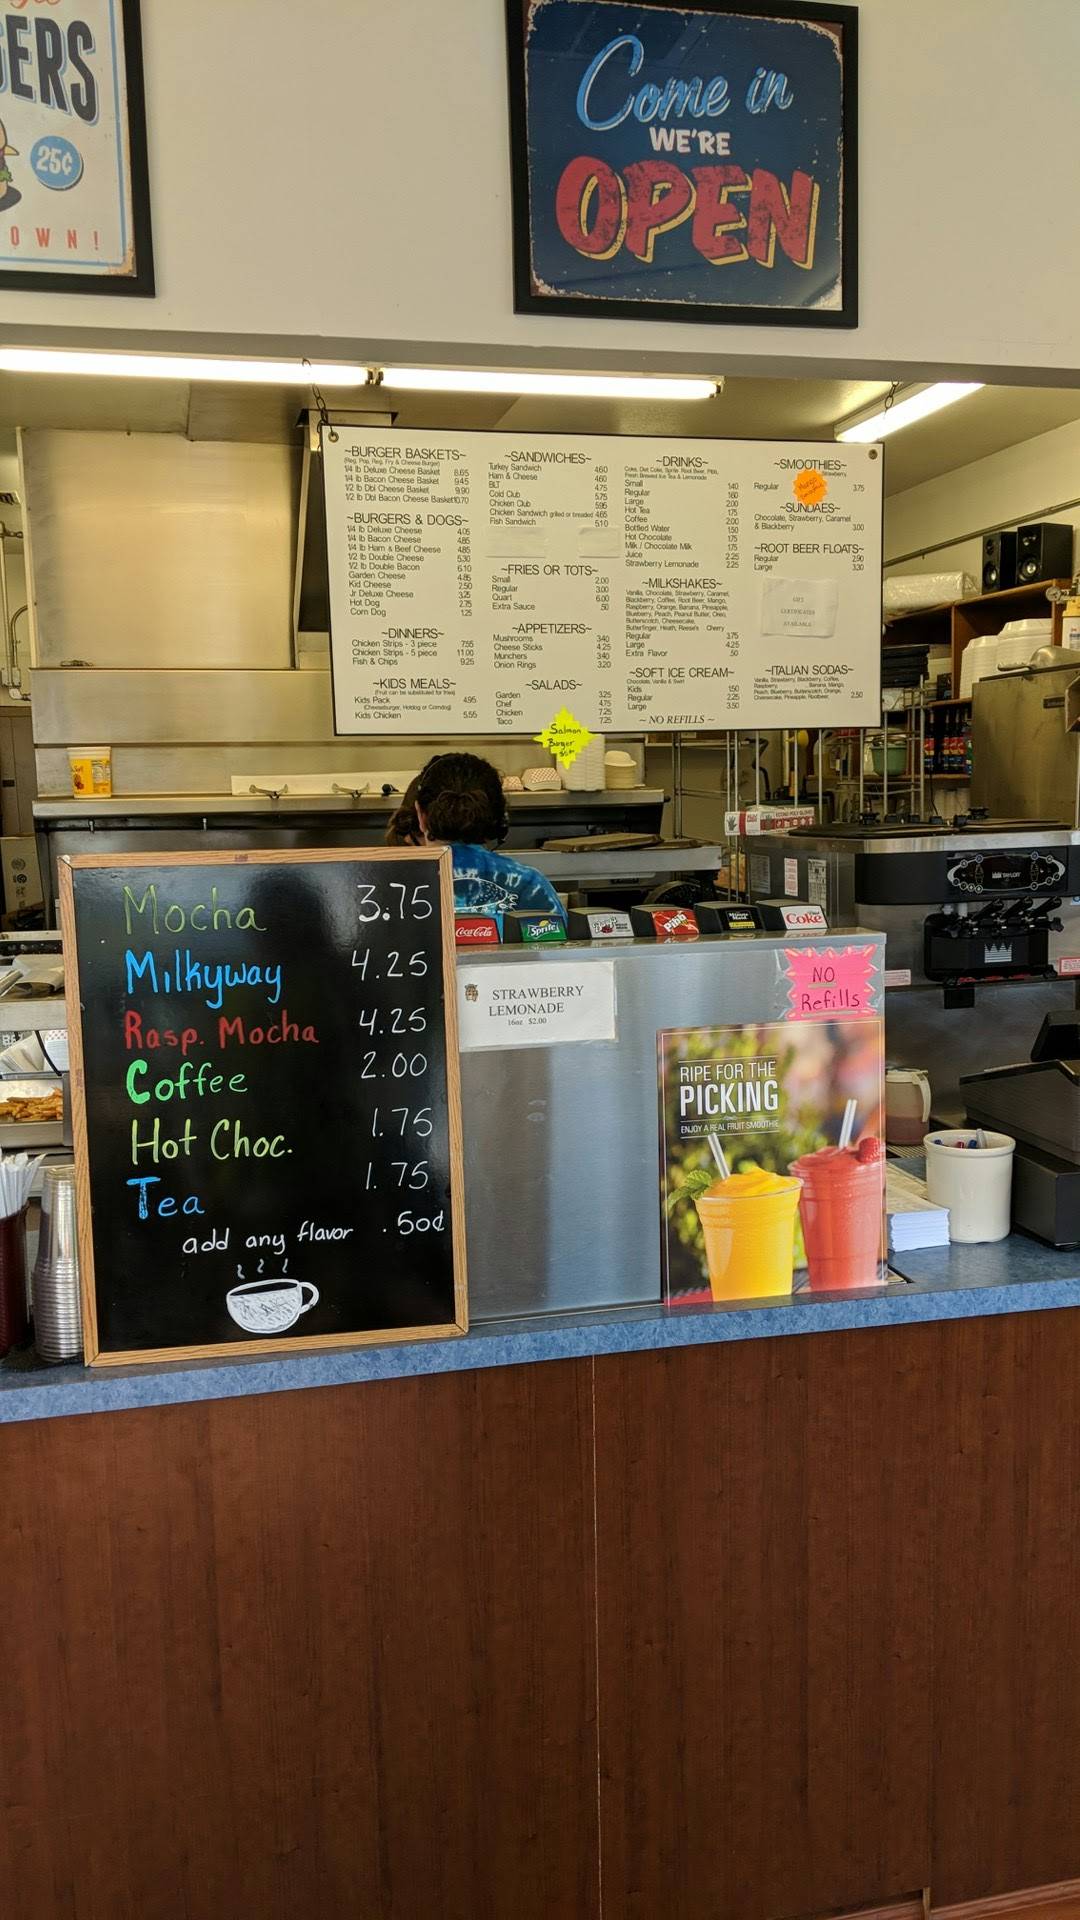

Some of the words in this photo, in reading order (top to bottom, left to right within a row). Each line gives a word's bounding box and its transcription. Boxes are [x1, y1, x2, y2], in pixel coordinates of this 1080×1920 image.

[0, 14, 99, 126] ERS
[576, 34, 731, 131] Come
[745, 67, 793, 114] in
[649, 127, 731, 156] WE'RE
[35, 145, 73, 176] 25¢
[556, 155, 820, 270] OPEN
[363, 465, 387, 474] Deluxe
[389, 466, 416, 475] Cheese
[417, 467, 440, 476] Basket
[488, 462, 509, 472] Turkey
[510, 463, 542, 472] Sandwich
[488, 472, 504, 480] Ham
[512, 472, 538, 480] Cheese
[489, 481, 501, 489] BLT
[489, 490, 504, 498] Cold
[506, 490, 521, 498] Club
[624, 488, 650, 498] Regular
[489, 508, 515, 517] Chicken
[517, 509, 548, 518] Sandwich
[624, 506, 637, 514] Hot
[639, 506, 650, 514] Tea
[414, 514, 424, 525] &
[624, 515, 648, 523] Coffee
[367, 525, 392, 534] Deluxe
[394, 526, 422, 535] Cheese
[625, 524, 649, 532] Bottled
[650, 524, 670, 532] Water
[761, 523, 795, 532] Blackberry
[367, 544, 386, 552] Ham
[394, 544, 412, 553] Beef
[413, 545, 441, 554] Cheese
[792, 543, 820, 554] BEER
[625, 551, 643, 559] Juice
[368, 562, 395, 570] Double
[396, 562, 421, 571] Bacon
[625, 559, 663, 569] Strawberry
[664, 560, 699, 568] Lemonade
[543, 564, 560, 576] OR
[348, 571, 376, 579] Garden
[377, 571, 406, 580] Cheese
[491, 575, 511, 583] Small
[491, 584, 518, 594] Regular
[492, 593, 512, 601] Quart
[349, 599, 363, 607] Hot
[364, 599, 380, 608] Dog
[492, 602, 511, 610] Extra
[513, 602, 536, 611] Sauce
[350, 608, 369, 617] Corn
[371, 608, 387, 617] Dog
[492, 634, 534, 642] Mushrooms
[351, 639, 380, 648] Chicken
[382, 640, 404, 648] Strips
[410, 640, 416, 648] 3
[417, 641, 438, 649] piece
[493, 643, 521, 651] Cheese
[522, 643, 543, 651] Sticks
[625, 641, 645, 650] Large
[494, 652, 528, 660] Munchers
[648, 649, 668, 657] Flavor
[352, 657, 368, 665] Fish
[370, 658, 376, 666] &
[377, 657, 398, 666] Chips
[494, 661, 515, 669] Onion
[517, 661, 537, 670] Rings
[668, 667, 685, 678] ICE
[354, 696, 370, 704] Kids
[372, 696, 391, 704] Pack
[495, 691, 521, 699] Garden
[627, 694, 653, 703] Regular
[496, 700, 512, 708] Chef
[627, 703, 647, 712] Large
[497, 717, 513, 725] Taco
[649, 715, 664, 724] NO
[666, 715, 705, 724] REFILLS
[549, 723, 582, 735] Salmon
[124, 884, 267, 935] Mocha
[357, 884, 434, 923] 3.75
[786, 911, 822, 925] Coke
[530, 924, 557, 936] Sprite
[125, 949, 282, 1009] Milkyway
[351, 949, 428, 981] 4.25
[812, 967, 836, 982] NO
[492, 985, 584, 1001] STRAWBERRY
[800, 994, 861, 1011] Refills
[489, 1002, 565, 1017] LEMONADE
[528, 1017, 547, 1025] $2.00
[125, 1010, 205, 1055] Rasp.
[218, 1009, 319, 1049] Mocha
[359, 1007, 427, 1036] 4.25
[680, 1065, 713, 1083] RIPE
[716, 1063, 744, 1080] FOR
[748, 1061, 777, 1078] THE
[126, 1059, 248, 1104] Coffee
[361, 1052, 428, 1079] 2.00
[680, 1080, 779, 1117] PICKING
[680, 1124, 703, 1134] ENJOY
[703, 1124, 710, 1132] A
[710, 1122, 726, 1131] REAL
[727, 1121, 745, 1130] FRUIT
[746, 1119, 780, 1129] SMOOTHIE
[131, 1118, 197, 1165] Hot
[210, 1119, 293, 1159] Choc.
[372, 1107, 433, 1137] 1.75
[126, 1176, 205, 1220] Tea
[365, 1161, 429, 1190] 1.75
[182, 1227, 228, 1255] add
[245, 1235, 286, 1260] any
[296, 1221, 353, 1243] flavor
